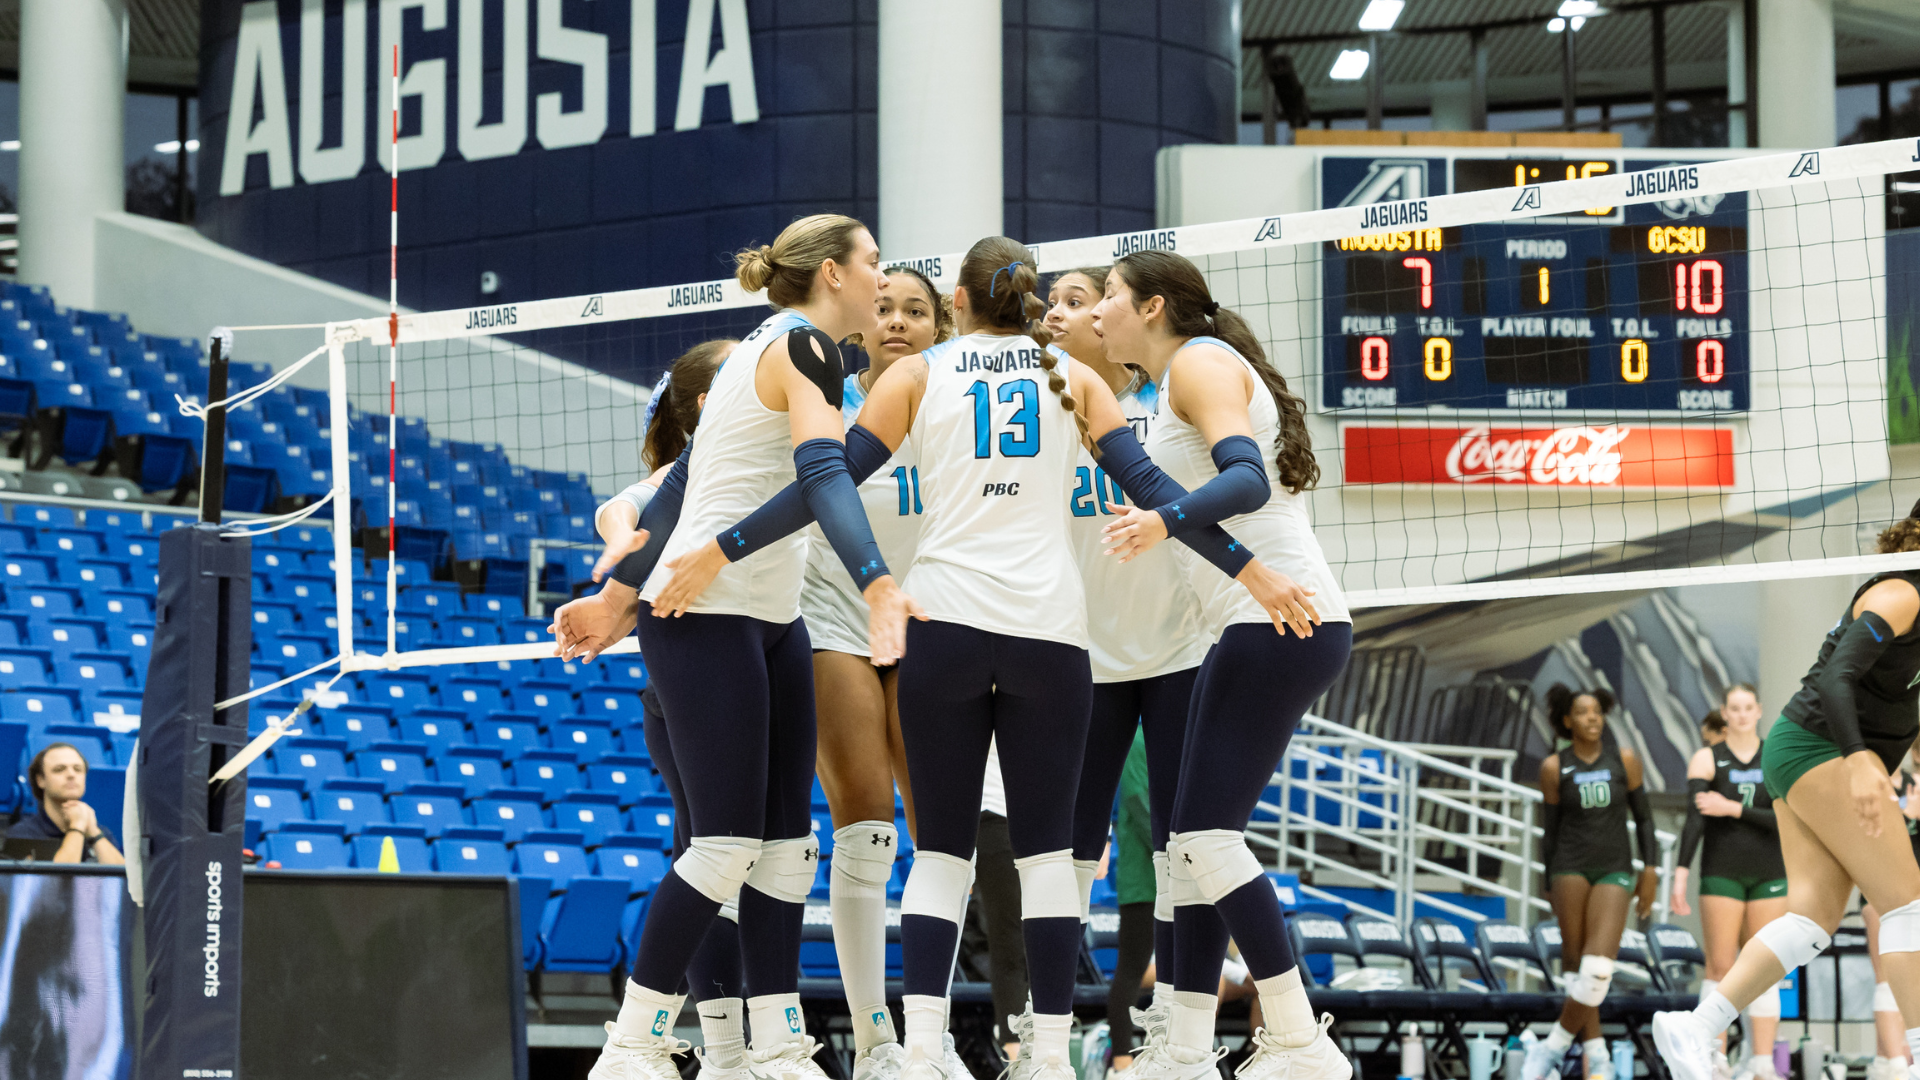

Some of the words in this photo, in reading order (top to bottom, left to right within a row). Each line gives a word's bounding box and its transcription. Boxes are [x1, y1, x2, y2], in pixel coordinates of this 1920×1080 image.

[219, 0, 760, 196] AUGUSTA
[1625, 167, 1699, 197] JAGUARS
[1361, 200, 1428, 229] JAGUARS
[1113, 231, 1176, 257] JAGUARS
[1506, 239, 1567, 259] PERIOD
[1648, 226, 1706, 254] GCSU
[668, 284, 722, 308] JAGUARS
[1403, 257, 1432, 309] 7
[1538, 267, 1549, 304] 1
[1675, 260, 1723, 314] 10
[466, 306, 517, 329] JAGUARS
[1341, 316, 1397, 335] FOULS
[1415, 316, 1464, 336] T.O.L.
[1481, 317, 1546, 337] PLAYER
[1550, 318, 1595, 338] FOUL
[1611, 318, 1659, 338] T.O.L.
[1676, 318, 1732, 338] FOULS
[955, 348, 1042, 373] JAGUARS
[1361, 337, 1389, 380] 0
[1424, 337, 1452, 381] 0
[1621, 339, 1648, 383] 0
[1697, 339, 1724, 383] 0
[1342, 387, 1397, 407] SCORE
[1507, 388, 1567, 408] MATCH
[1677, 390, 1733, 409] SCORE
[963, 378, 1040, 459] 13
[1445, 426, 1630, 483] Coca-Cola
[982, 482, 1020, 497] PBC
[1070, 466, 1125, 517] 20
[1579, 781, 1611, 808] 10
[1738, 782, 1756, 808] 7
[205, 861, 223, 922] sports
[203, 923, 221, 997] imports
